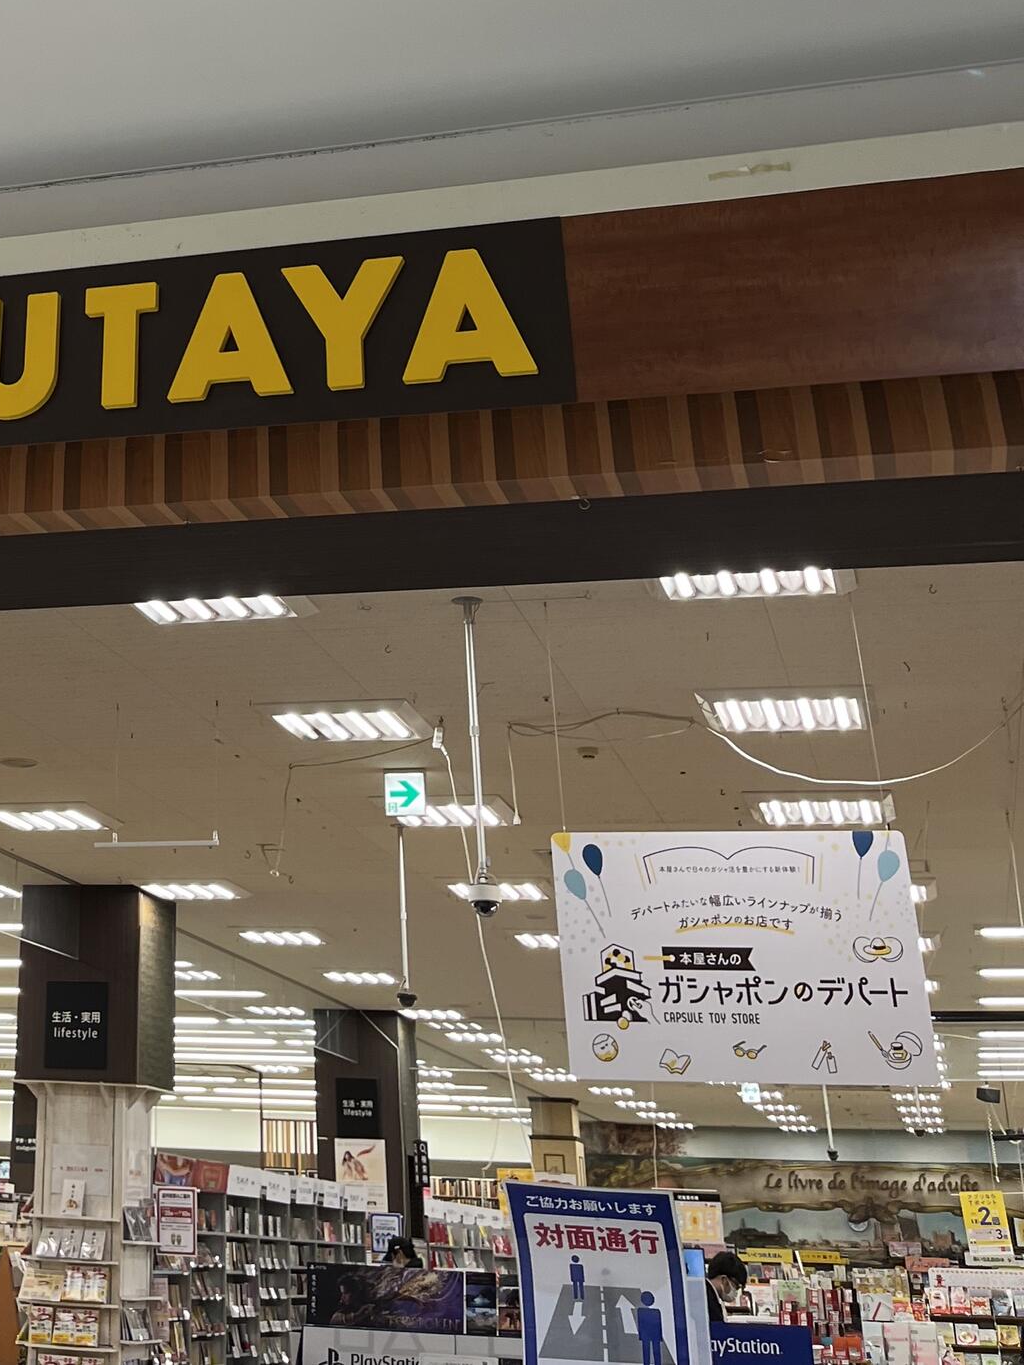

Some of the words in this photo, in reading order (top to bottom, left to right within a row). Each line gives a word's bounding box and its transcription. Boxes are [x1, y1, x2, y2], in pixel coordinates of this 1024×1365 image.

[631, 894, 842, 922] デパートみたいな幅広いラインナップが揃う
[679, 914, 793, 930] ガシャポンのお店です
[679, 952, 741, 966] 本屋さんの
[658, 975, 909, 1008] ガシャポンのデパート
[52, 1011, 101, 1024] 生活・実用
[664, 1012, 703, 1025] CAPSULE
[709, 1012, 727, 1025] TOY
[732, 1013, 760, 1025] STORE
[53, 1026, 98, 1041] lifestyle
[764, 1170, 782, 1190] Le
[788, 1171, 822, 1191] livre
[828, 1172, 845, 1191] de
[526, 1195, 656, 1216] ご協力お願いします
[533, 1222, 659, 1254] 対面通行
[711, 1337, 780, 1357] ayStation
[351, 1353, 419, 1365] PlayStati
